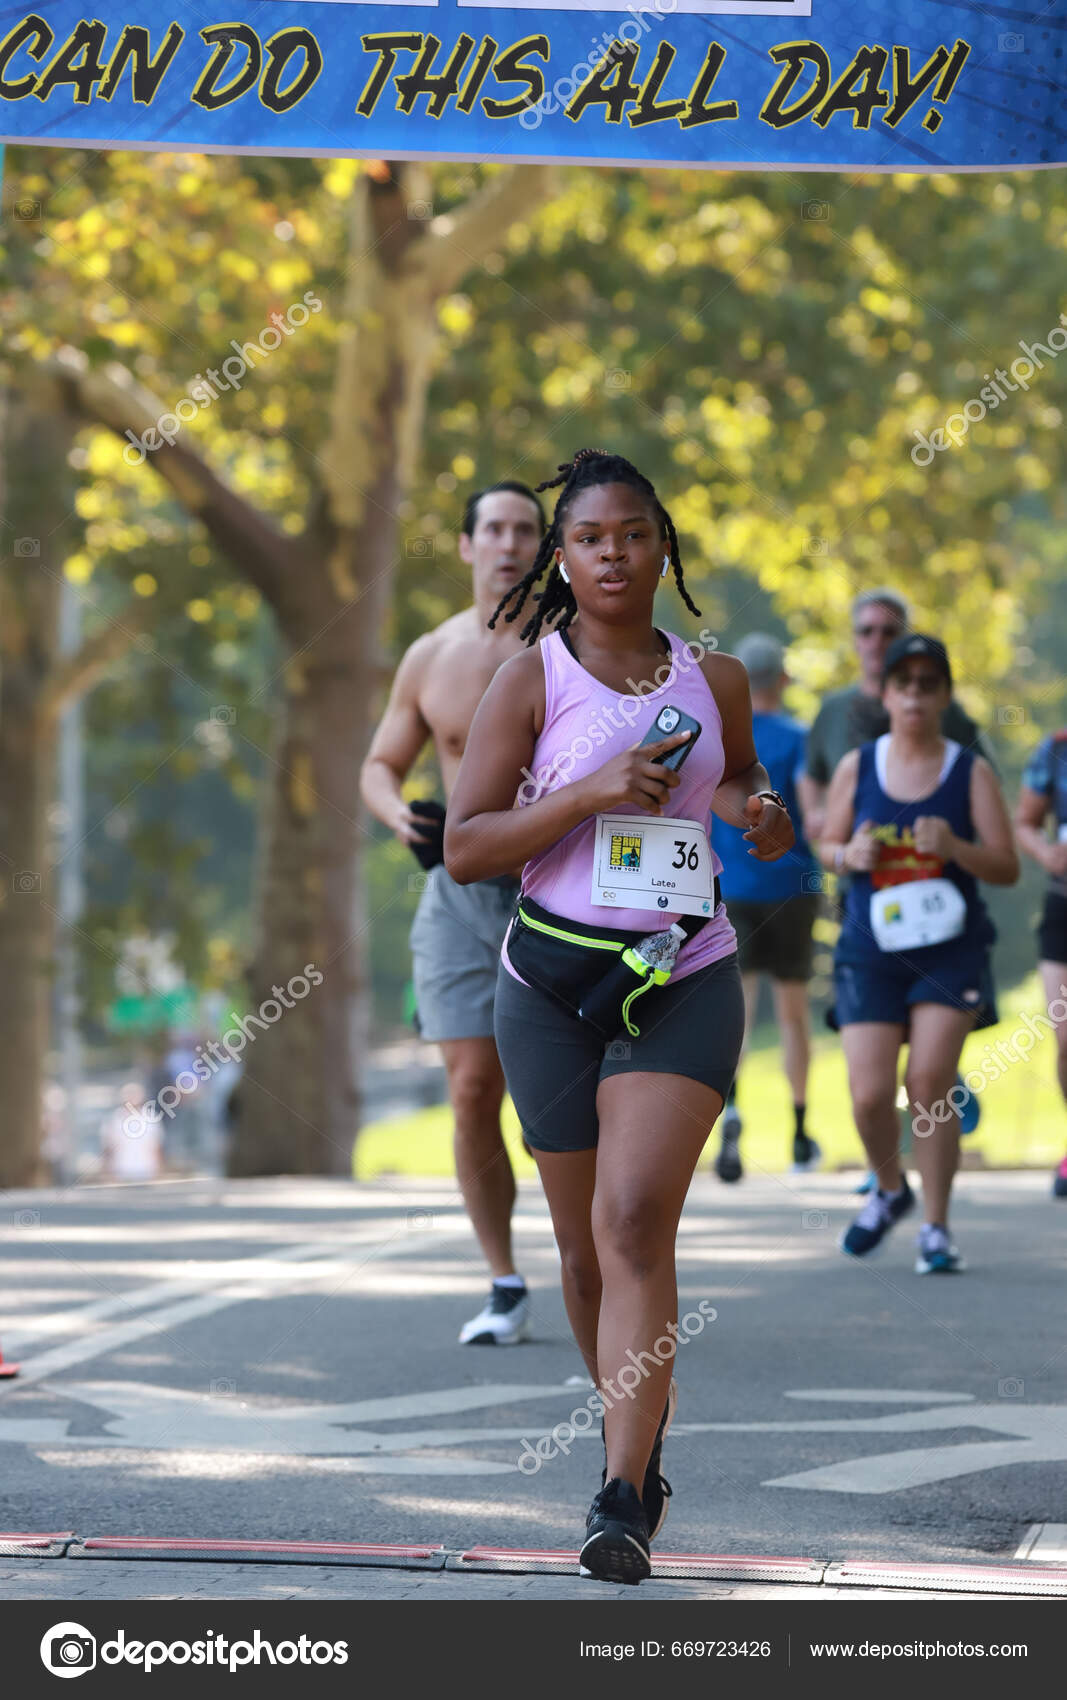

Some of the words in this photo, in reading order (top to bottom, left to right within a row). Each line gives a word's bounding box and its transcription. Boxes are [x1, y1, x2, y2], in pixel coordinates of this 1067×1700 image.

[0, 14, 185, 106] CAN
[191, 22, 324, 113] DO
[355, 32, 549, 119] THIS
[564, 38, 738, 129] ALL
[759, 39, 971, 133] DAY!
[610, 836, 623, 866] COMIC
[622, 837, 641, 848] RUN
[671, 840, 699, 871] 36
[651, 878, 676, 889] Latea
